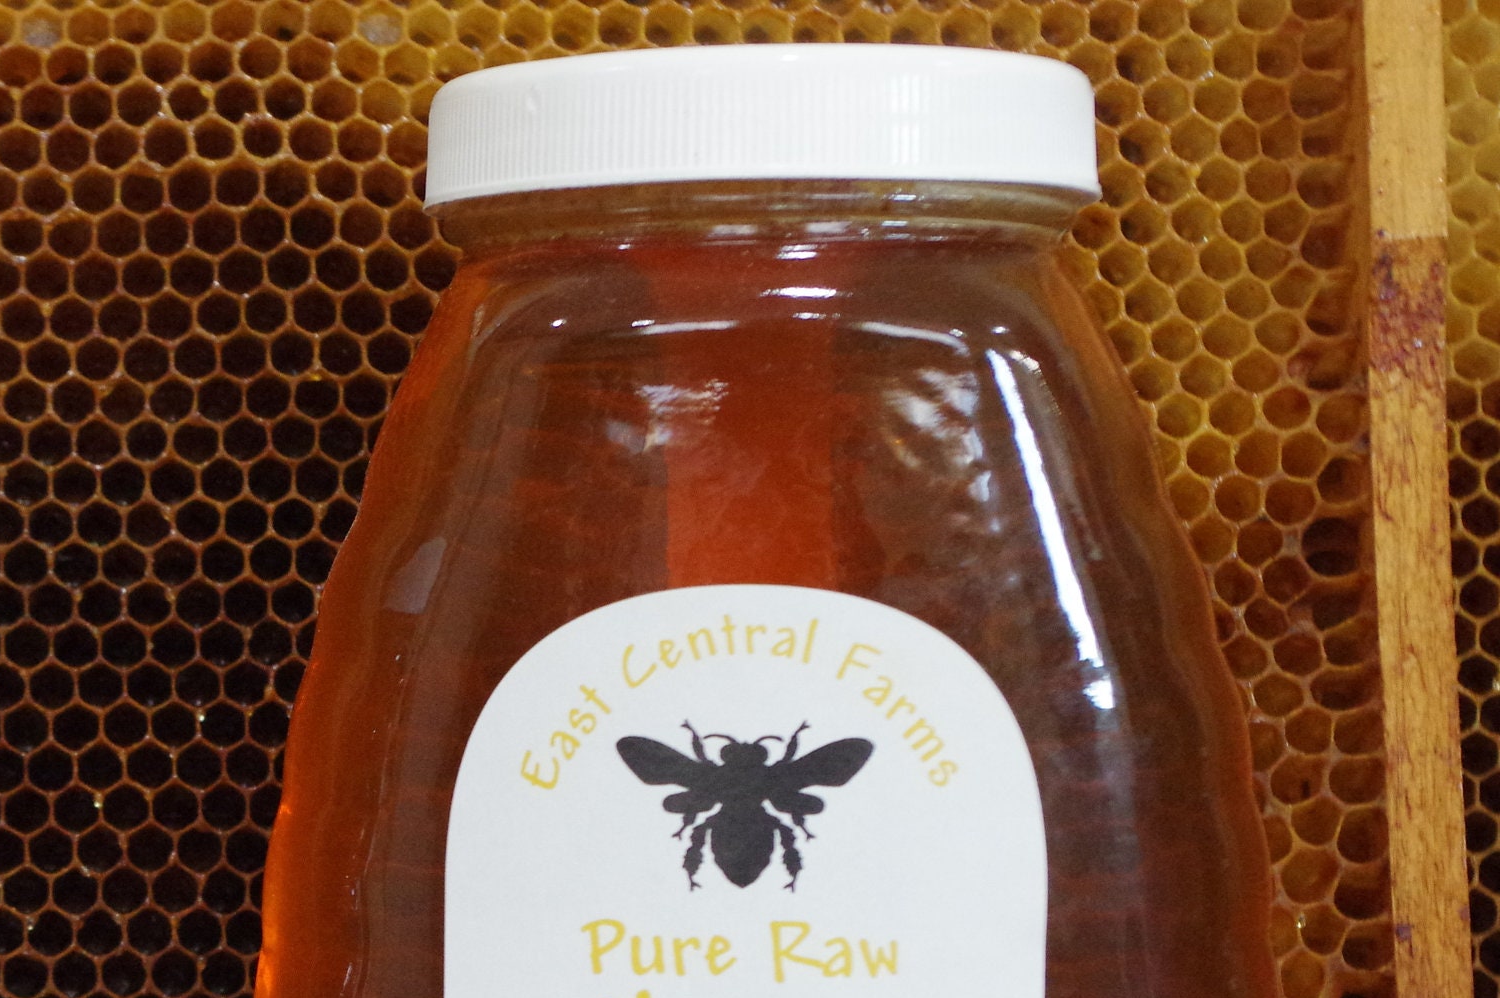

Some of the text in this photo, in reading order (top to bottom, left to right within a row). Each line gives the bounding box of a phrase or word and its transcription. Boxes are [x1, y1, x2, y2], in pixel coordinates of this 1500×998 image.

[520, 614, 960, 790] East Central Farms
[581, 919, 898, 983] Pure Raw
